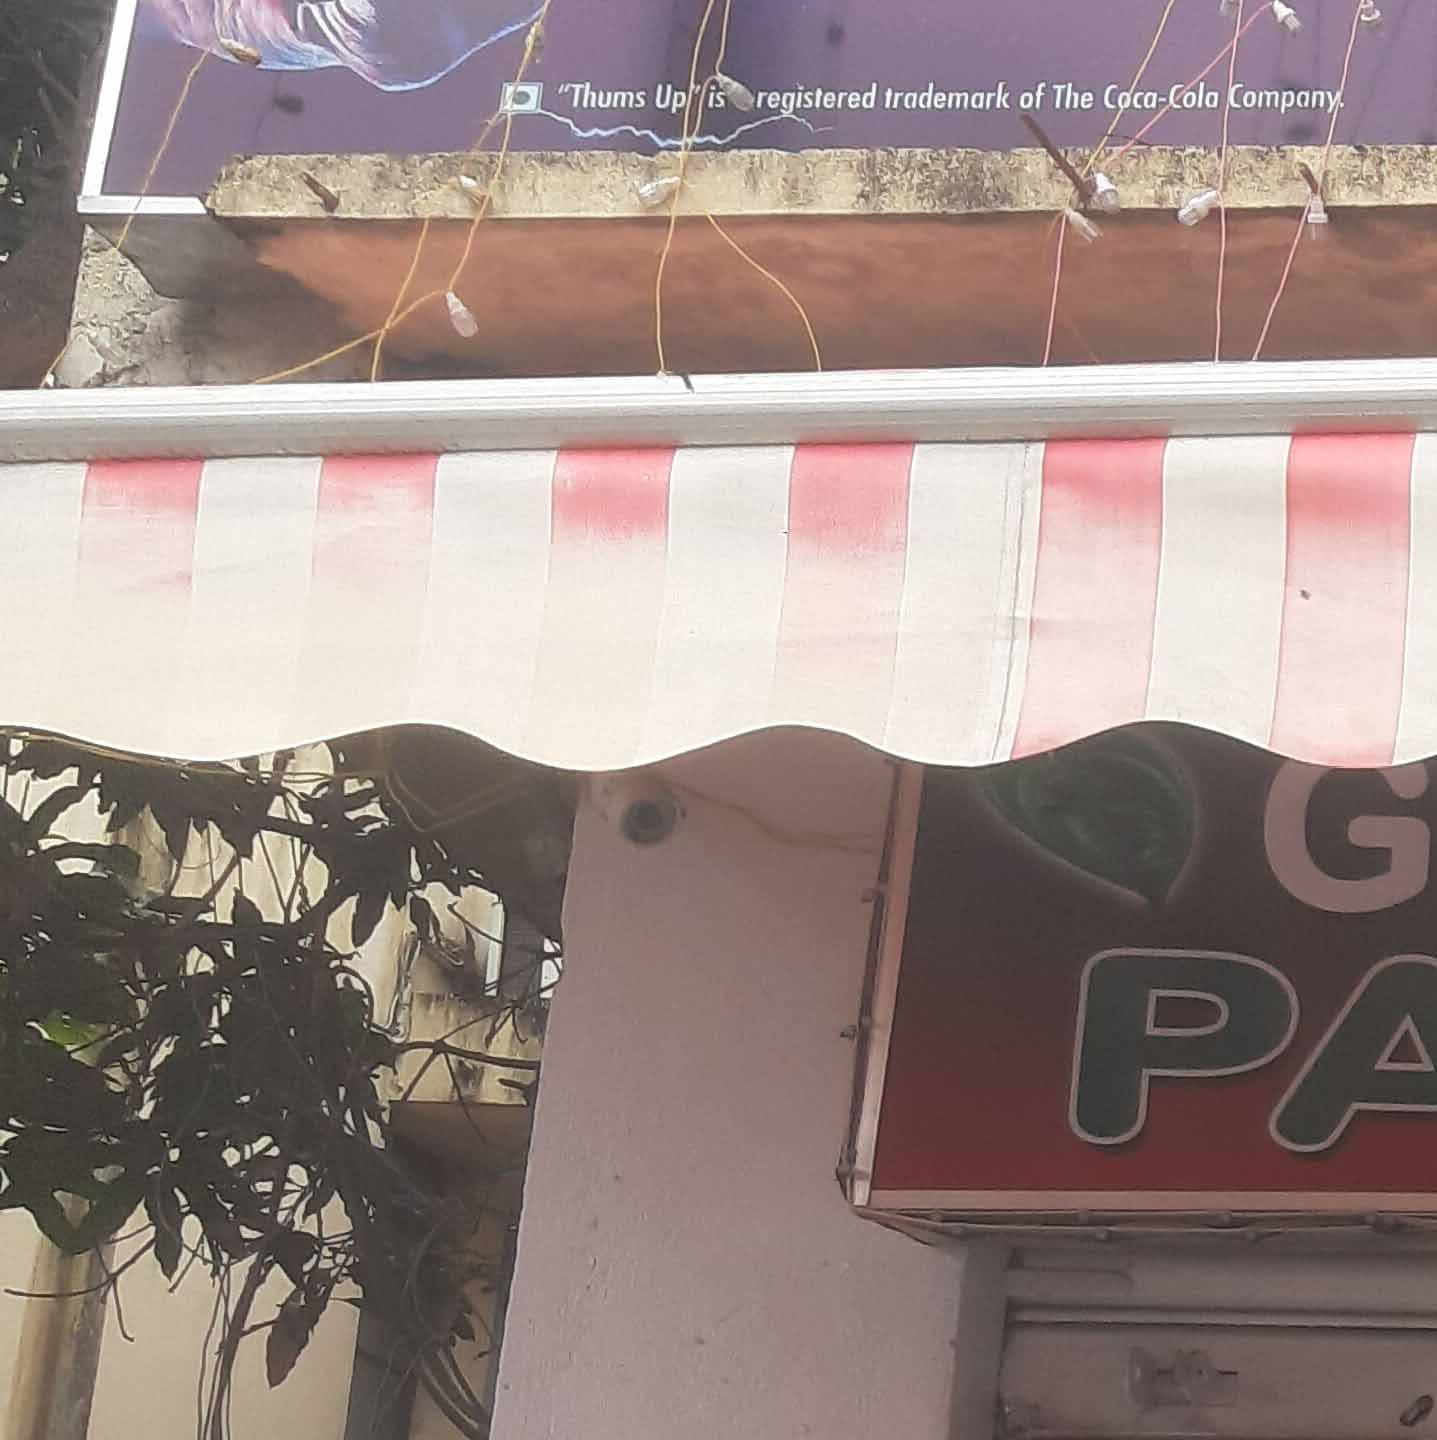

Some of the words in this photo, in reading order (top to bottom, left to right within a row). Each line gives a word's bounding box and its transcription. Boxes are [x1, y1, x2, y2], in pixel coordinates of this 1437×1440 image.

[707, 82, 726, 110] is
[756, 83, 876, 114] registered
[884, 84, 1009, 110] trademark
[1019, 83, 1046, 111] of
[1053, 84, 1095, 111] The
[1103, 84, 1220, 111] Coca-Cola
[1227, 84, 1346, 115] Company.
